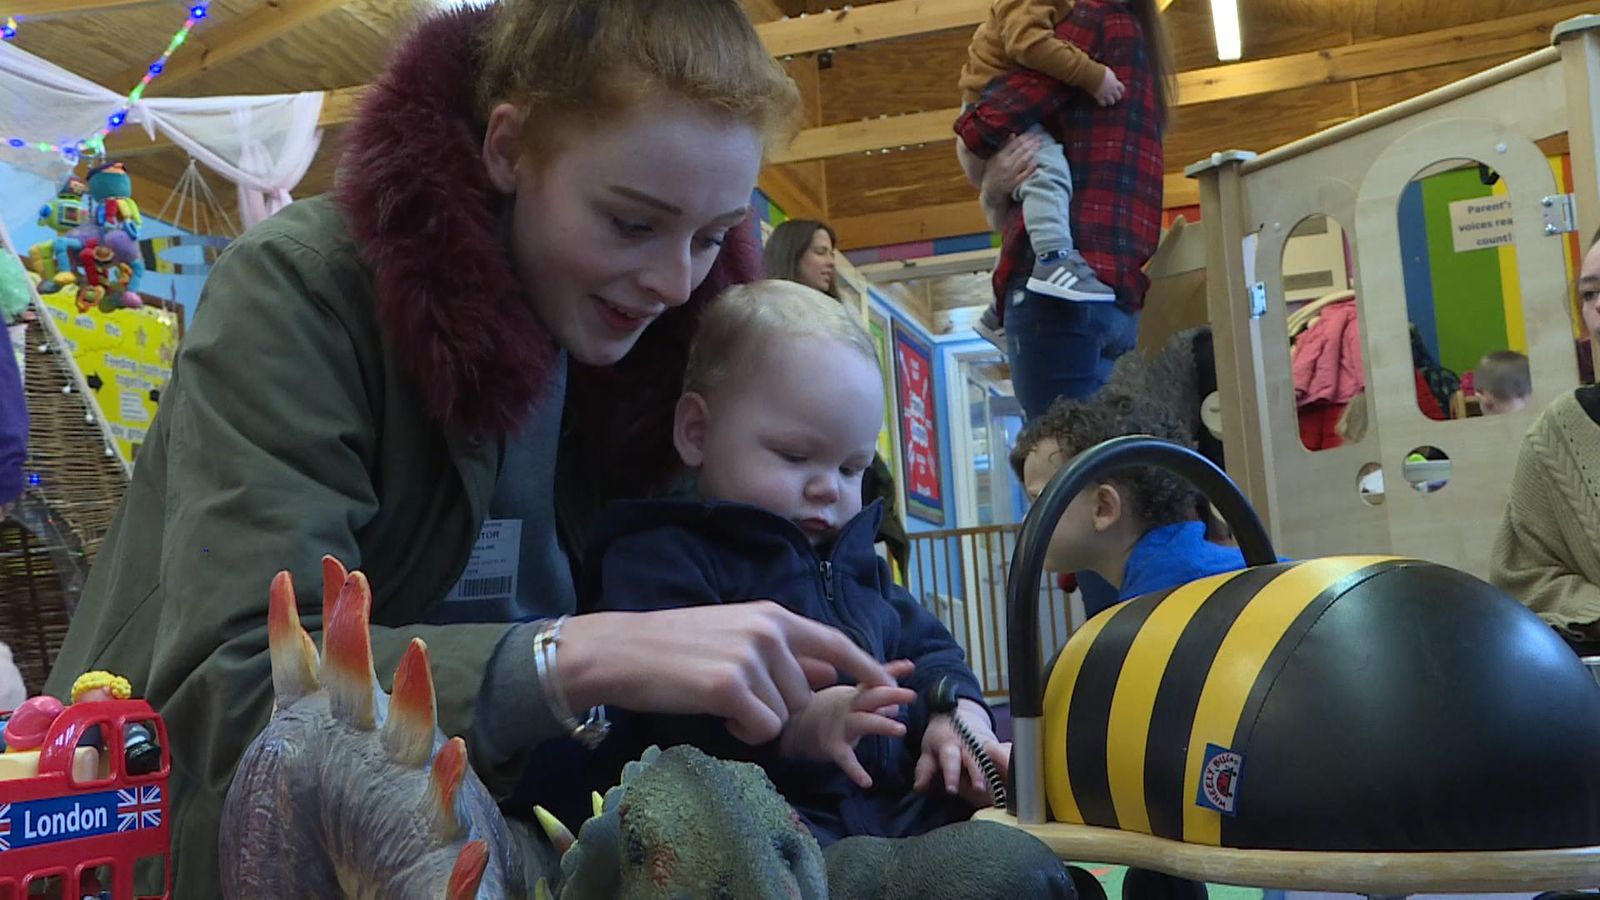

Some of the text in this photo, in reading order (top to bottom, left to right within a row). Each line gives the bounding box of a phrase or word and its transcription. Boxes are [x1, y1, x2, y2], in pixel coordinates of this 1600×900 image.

[1459, 217, 1513, 232] voices rea
[104, 353, 137, 372] Feeding
[24, 802, 107, 839] London
